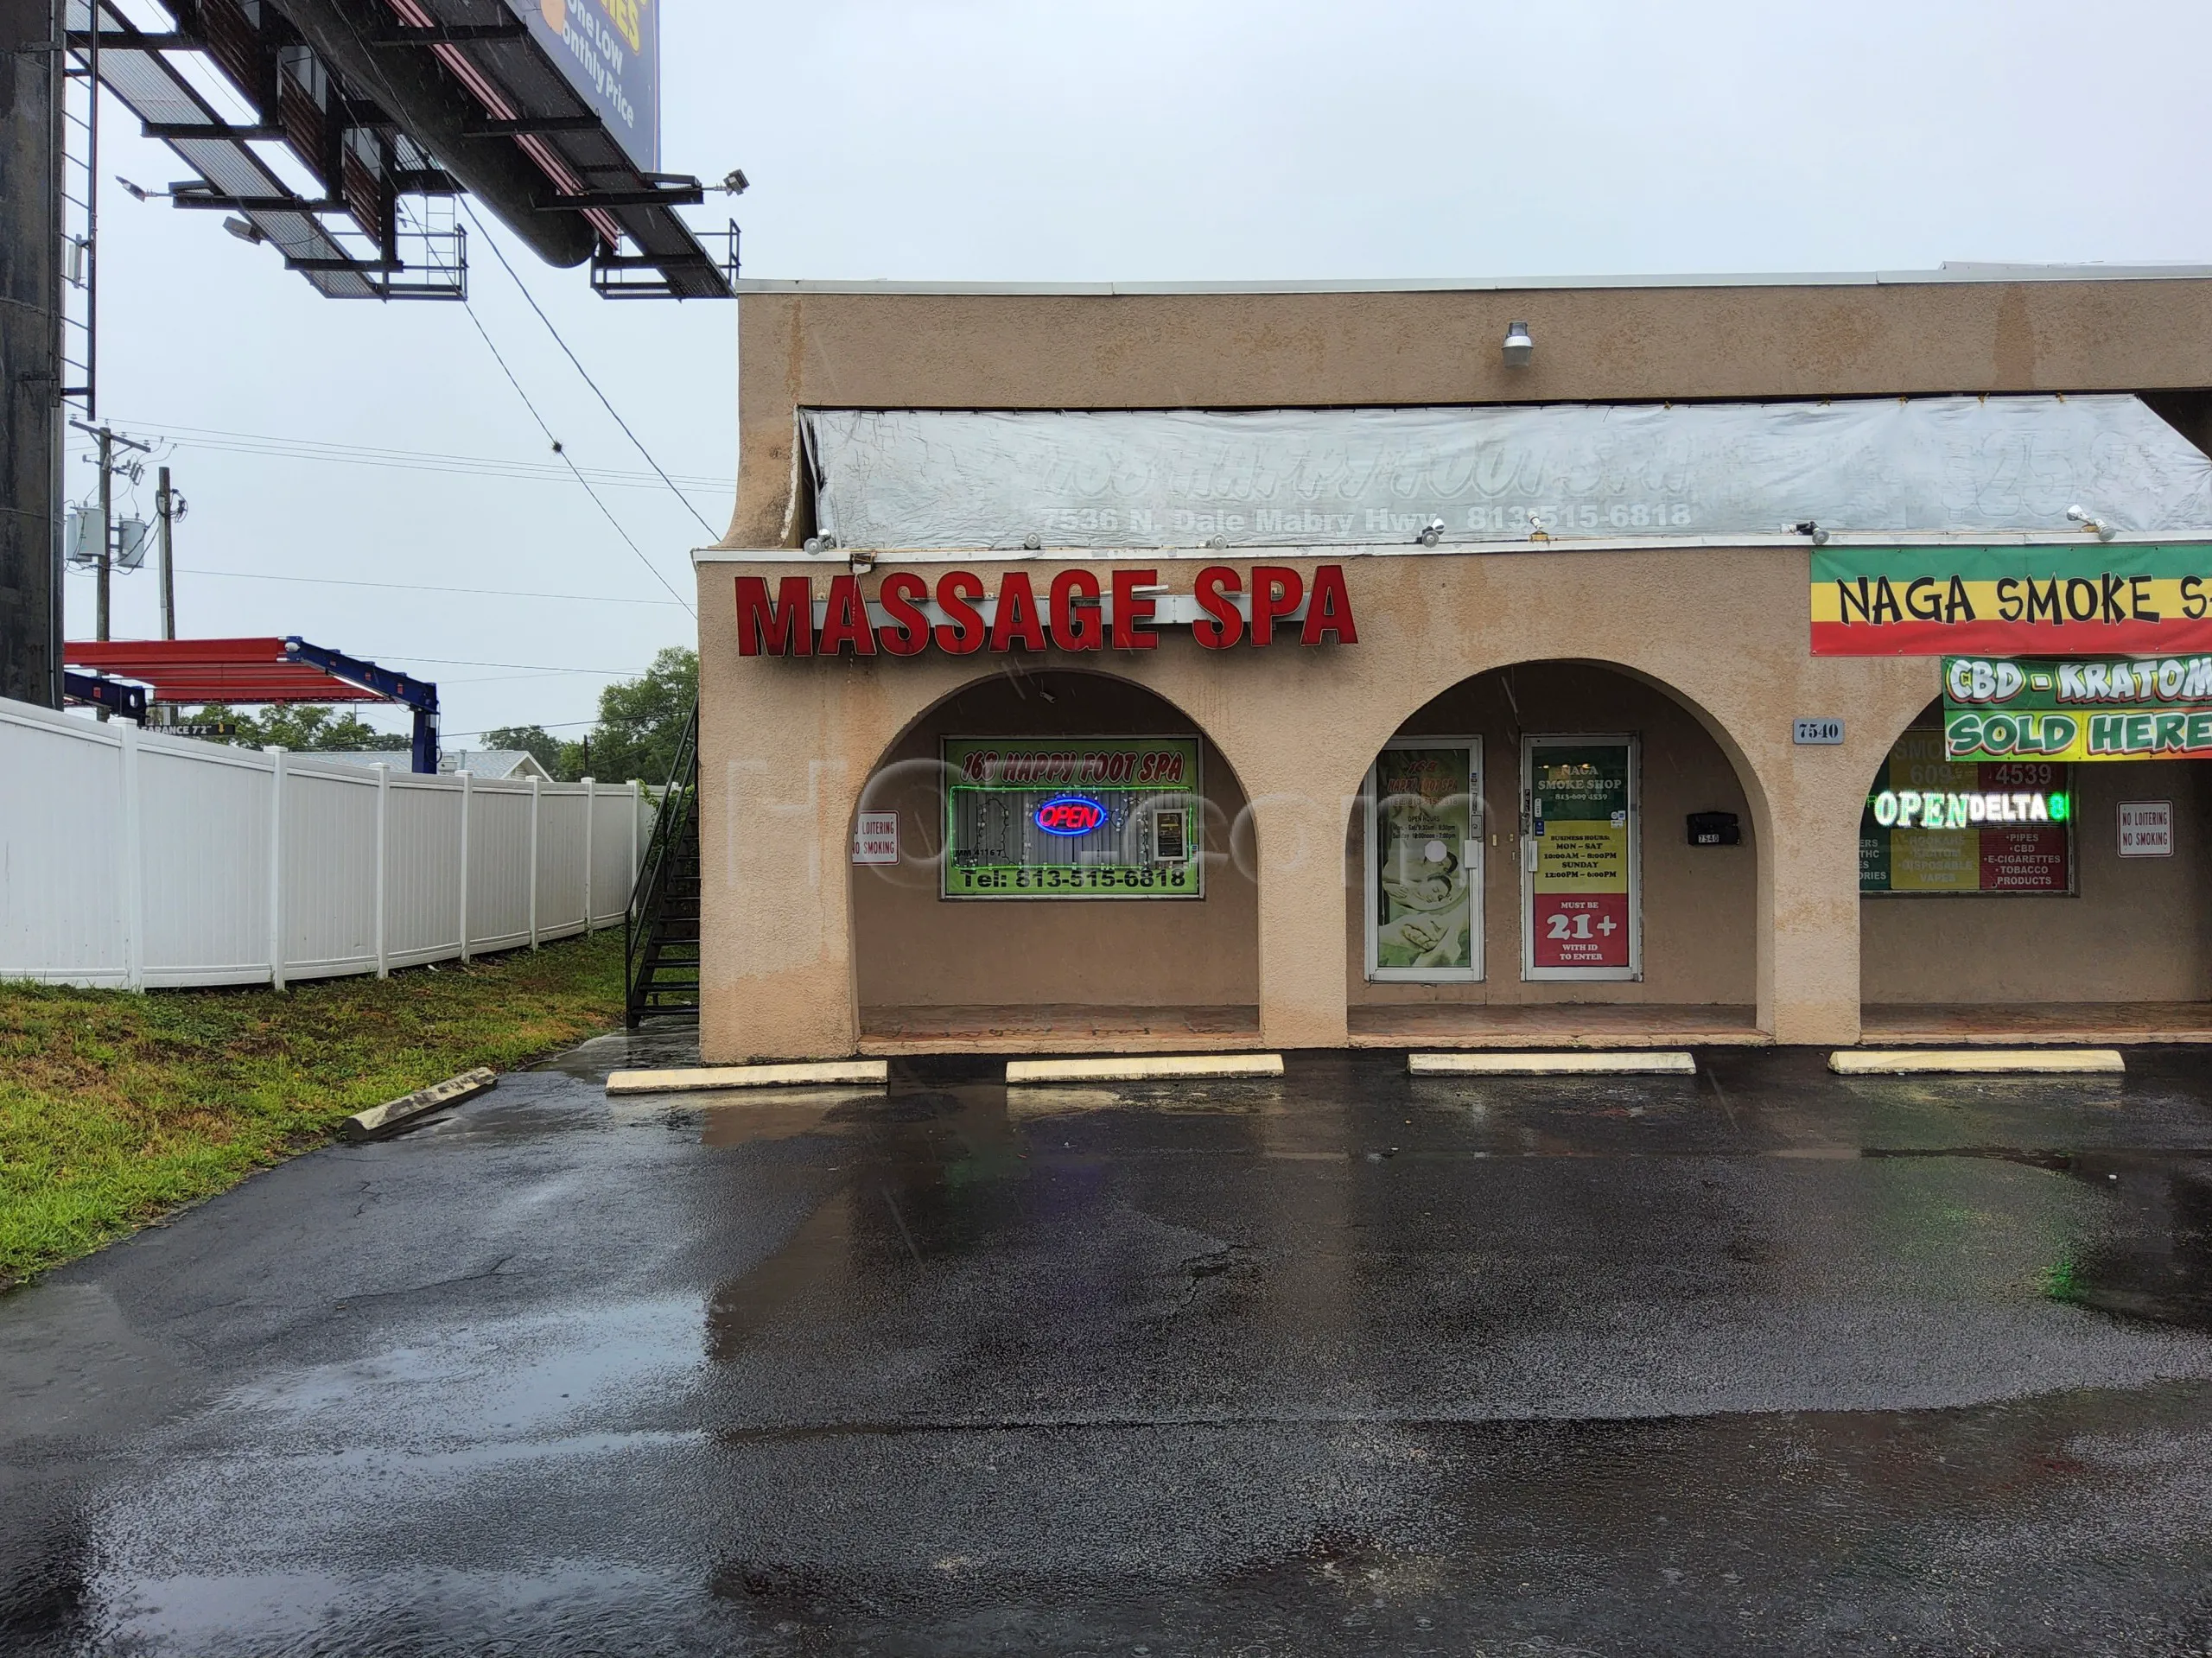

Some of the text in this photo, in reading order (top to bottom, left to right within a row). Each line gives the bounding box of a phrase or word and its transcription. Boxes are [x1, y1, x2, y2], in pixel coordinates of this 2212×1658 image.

[601, 0, 640, 52] IES
[567, 0, 623, 75] One LOW
[563, 20, 633, 129] onthly Price
[1174, 509, 1245, 532] Dale
[1255, 508, 1356, 536] Mabry
[1467, 504, 1692, 529] 813515-6818
[1834, 571, 2212, 626] NAGA SMOKE S
[734, 564, 1358, 657] MASSAGE SPA
[1947, 659, 2026, 702] CBD
[2056, 655, 2212, 702] KRATOM
[1799, 723, 1839, 739] 7540
[1948, 710, 2212, 756] SOLD HERE
[1894, 739, 1944, 760] SMO
[962, 751, 1185, 784] 168 HAPPY FOOT SPA
[1561, 765, 1599, 776] NAGA
[1995, 764, 2052, 785] 4539
[1538, 779, 1622, 790] SMOKE SHOP
[1040, 806, 1099, 829] OPEN
[1874, 791, 1970, 829] OPEN
[1969, 792, 2049, 822] DELTA
[2122, 811, 2168, 826] NO LOITERING
[862, 822, 894, 835] LOITERING
[2123, 832, 2168, 846] NO SMOKING
[864, 841, 894, 854] SMOKING
[2013, 844, 2036, 853] CBD
[1987, 854, 2062, 863] E-CIGARETTES
[959, 868, 1186, 888] Tel: 813-515-6818
[1997, 876, 2052, 885] PRODUCTS
[2000, 866, 2049, 874] TOBACCO
[1546, 913, 1618, 941] 21+
